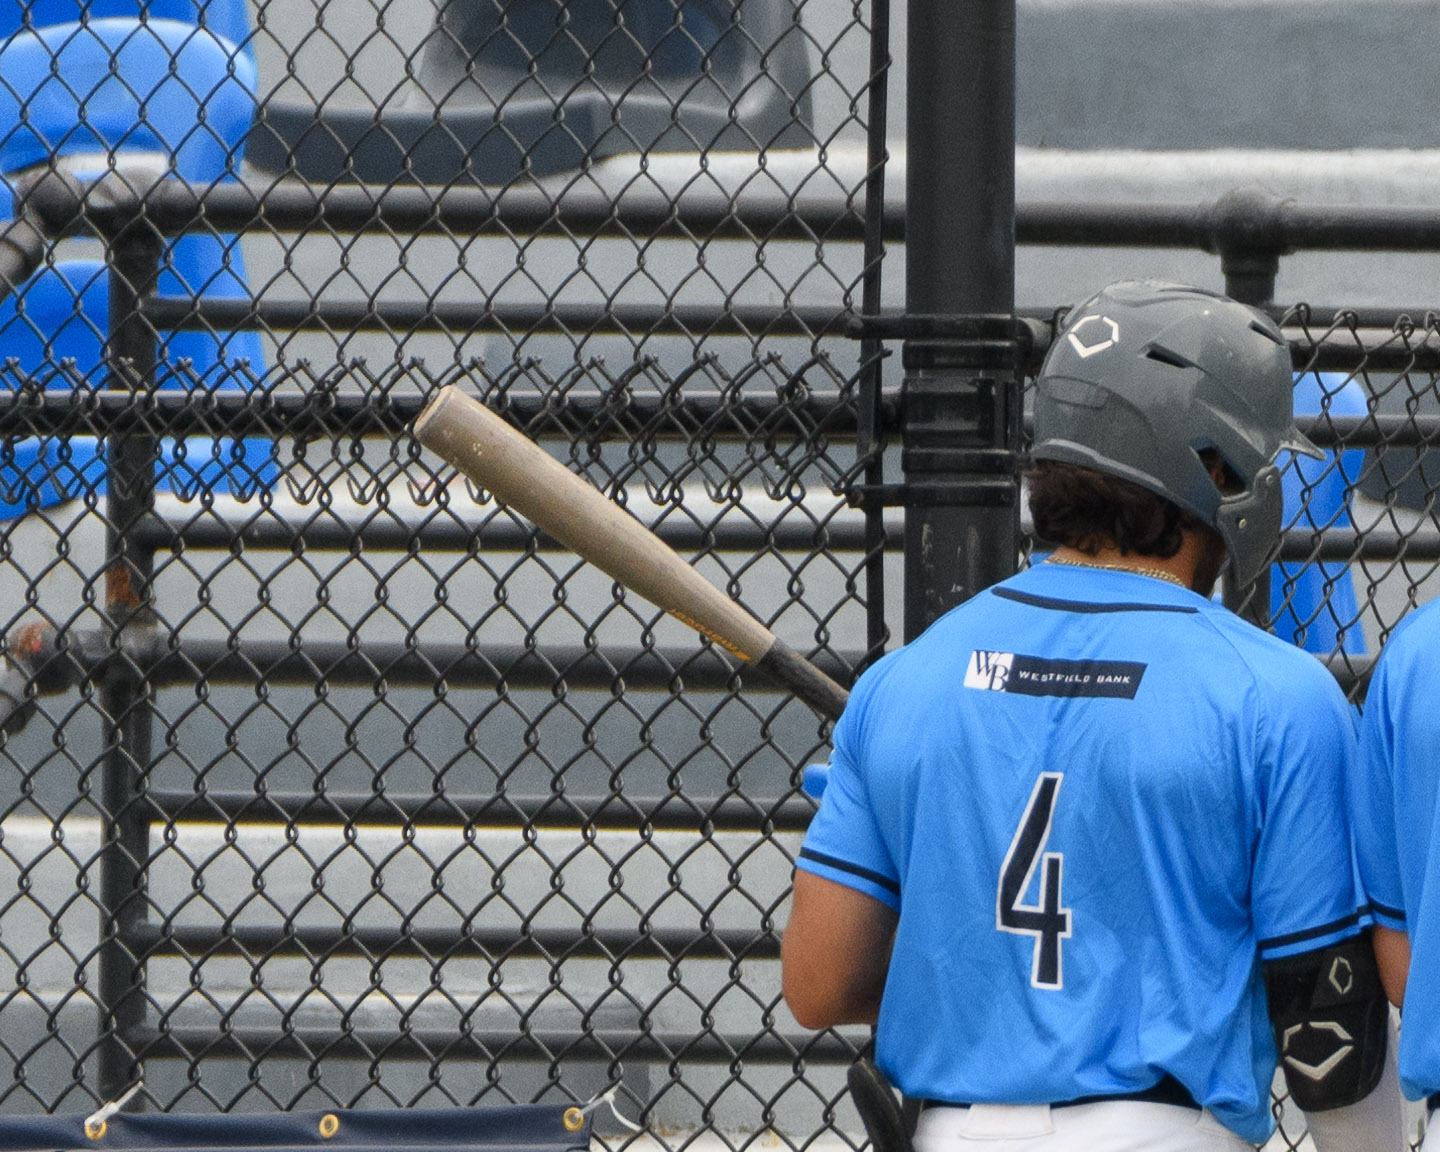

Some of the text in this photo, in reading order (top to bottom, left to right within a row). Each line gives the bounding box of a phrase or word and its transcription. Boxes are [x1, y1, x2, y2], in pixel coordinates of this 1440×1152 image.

[1019, 670, 1131, 684] WESTFIELD BANK
[995, 771, 1072, 991] 4
